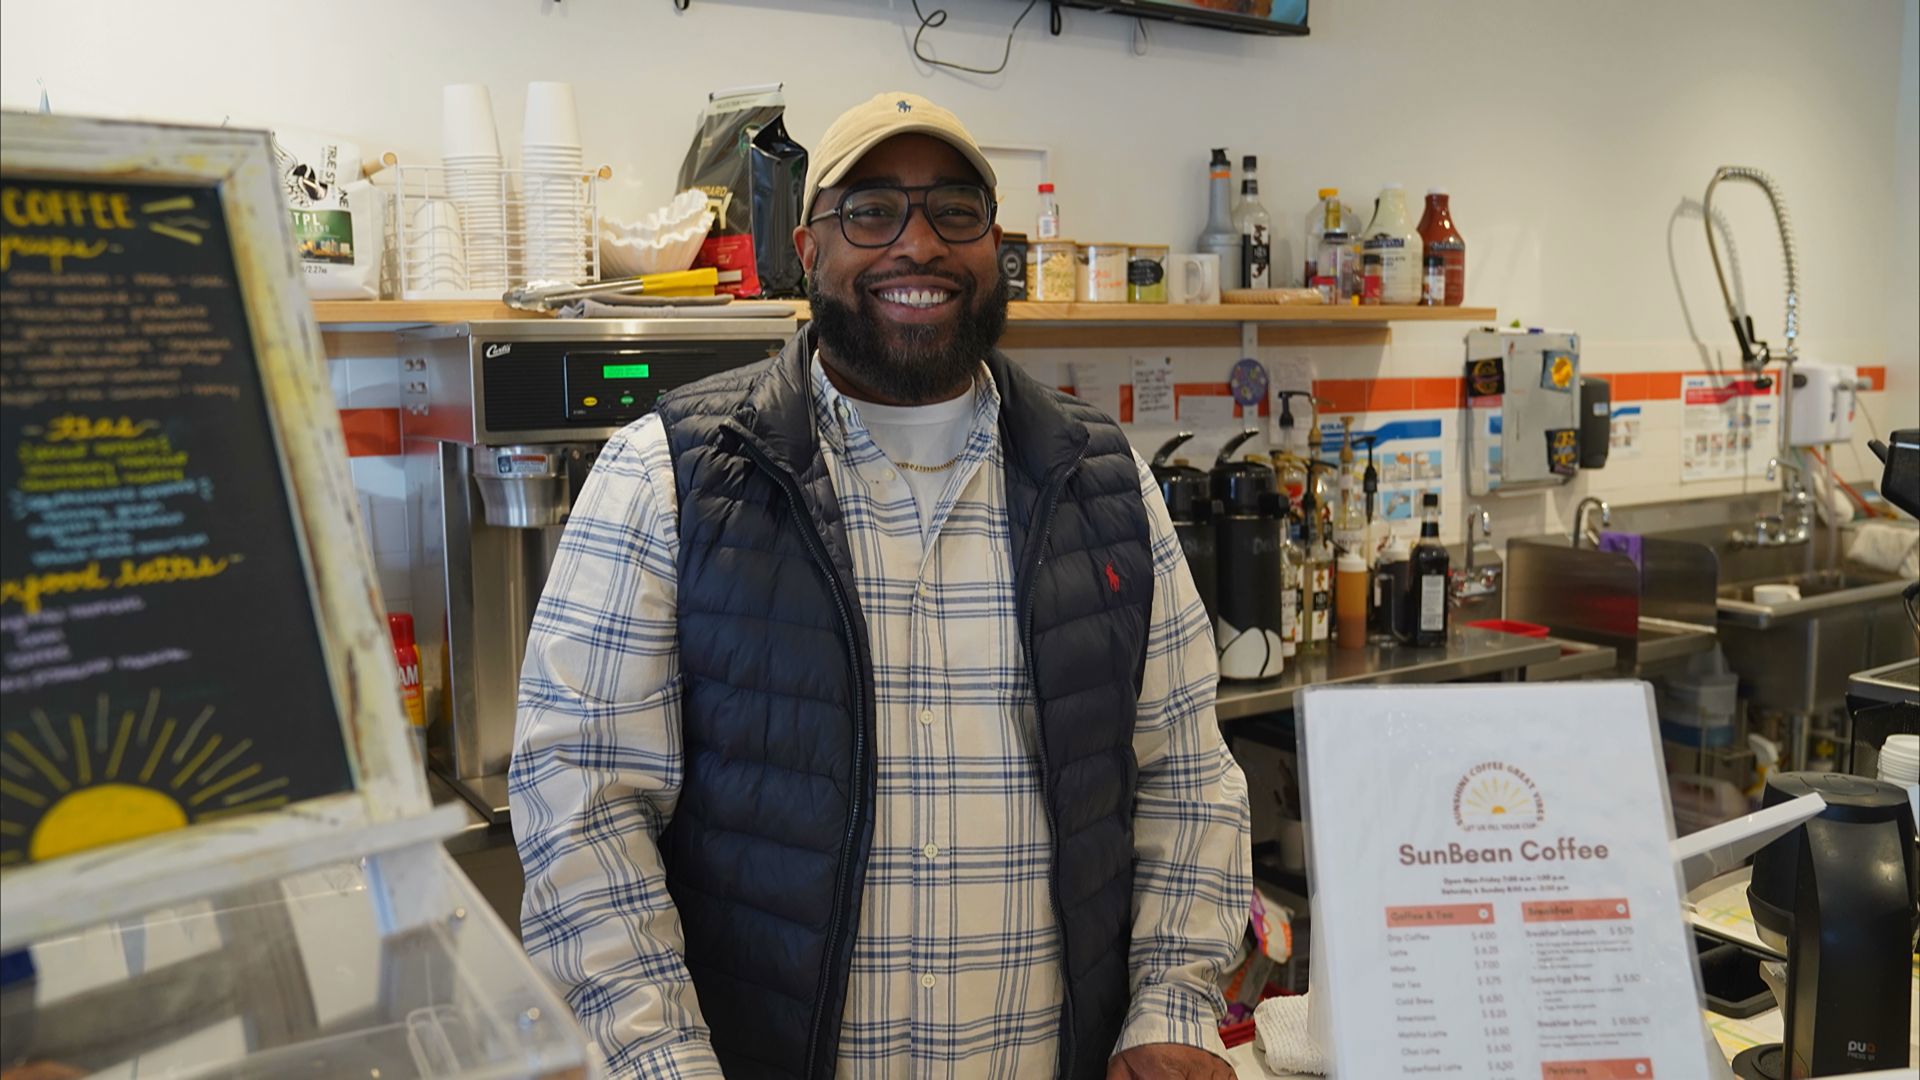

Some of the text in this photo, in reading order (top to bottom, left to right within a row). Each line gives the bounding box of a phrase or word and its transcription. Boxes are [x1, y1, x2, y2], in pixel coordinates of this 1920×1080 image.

[2, 188, 136, 230] COFFEE
[398, 663, 419, 687] AM
[1470, 761, 1504, 777] COFFEE
[1507, 764, 1536, 790] GREAT
[1399, 836, 1609, 867] SunBean Coffee
[1528, 906, 1574, 916] Breakfast
